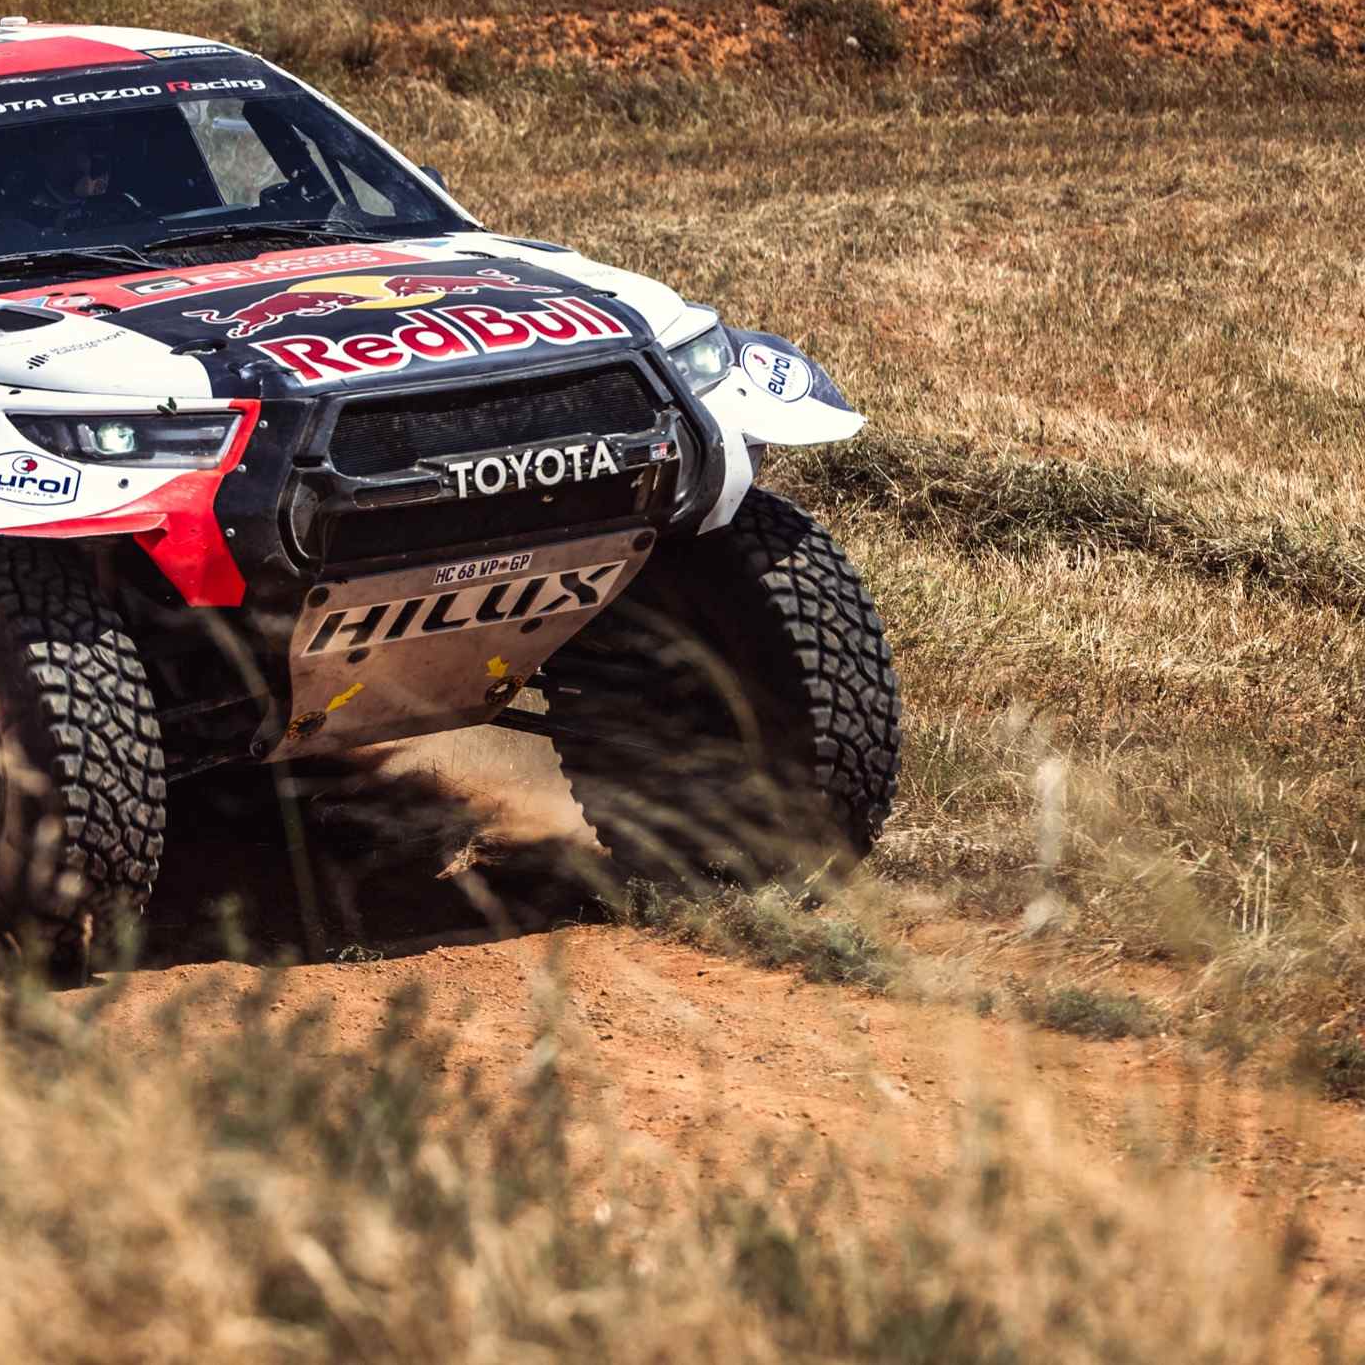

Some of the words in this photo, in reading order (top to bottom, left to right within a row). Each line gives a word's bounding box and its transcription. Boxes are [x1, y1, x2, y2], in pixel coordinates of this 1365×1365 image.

[52, 85, 162, 106] GAZOO
[165, 77, 266, 95] Racing
[256, 310, 477, 385] Red
[436, 296, 631, 354] Bull
[448, 440, 620, 499] TOYOTA
[435, 567, 456, 584] HC
[457, 563, 477, 580] 68
[509, 554, 531, 571] GP
[306, 562, 622, 654] HILUX
